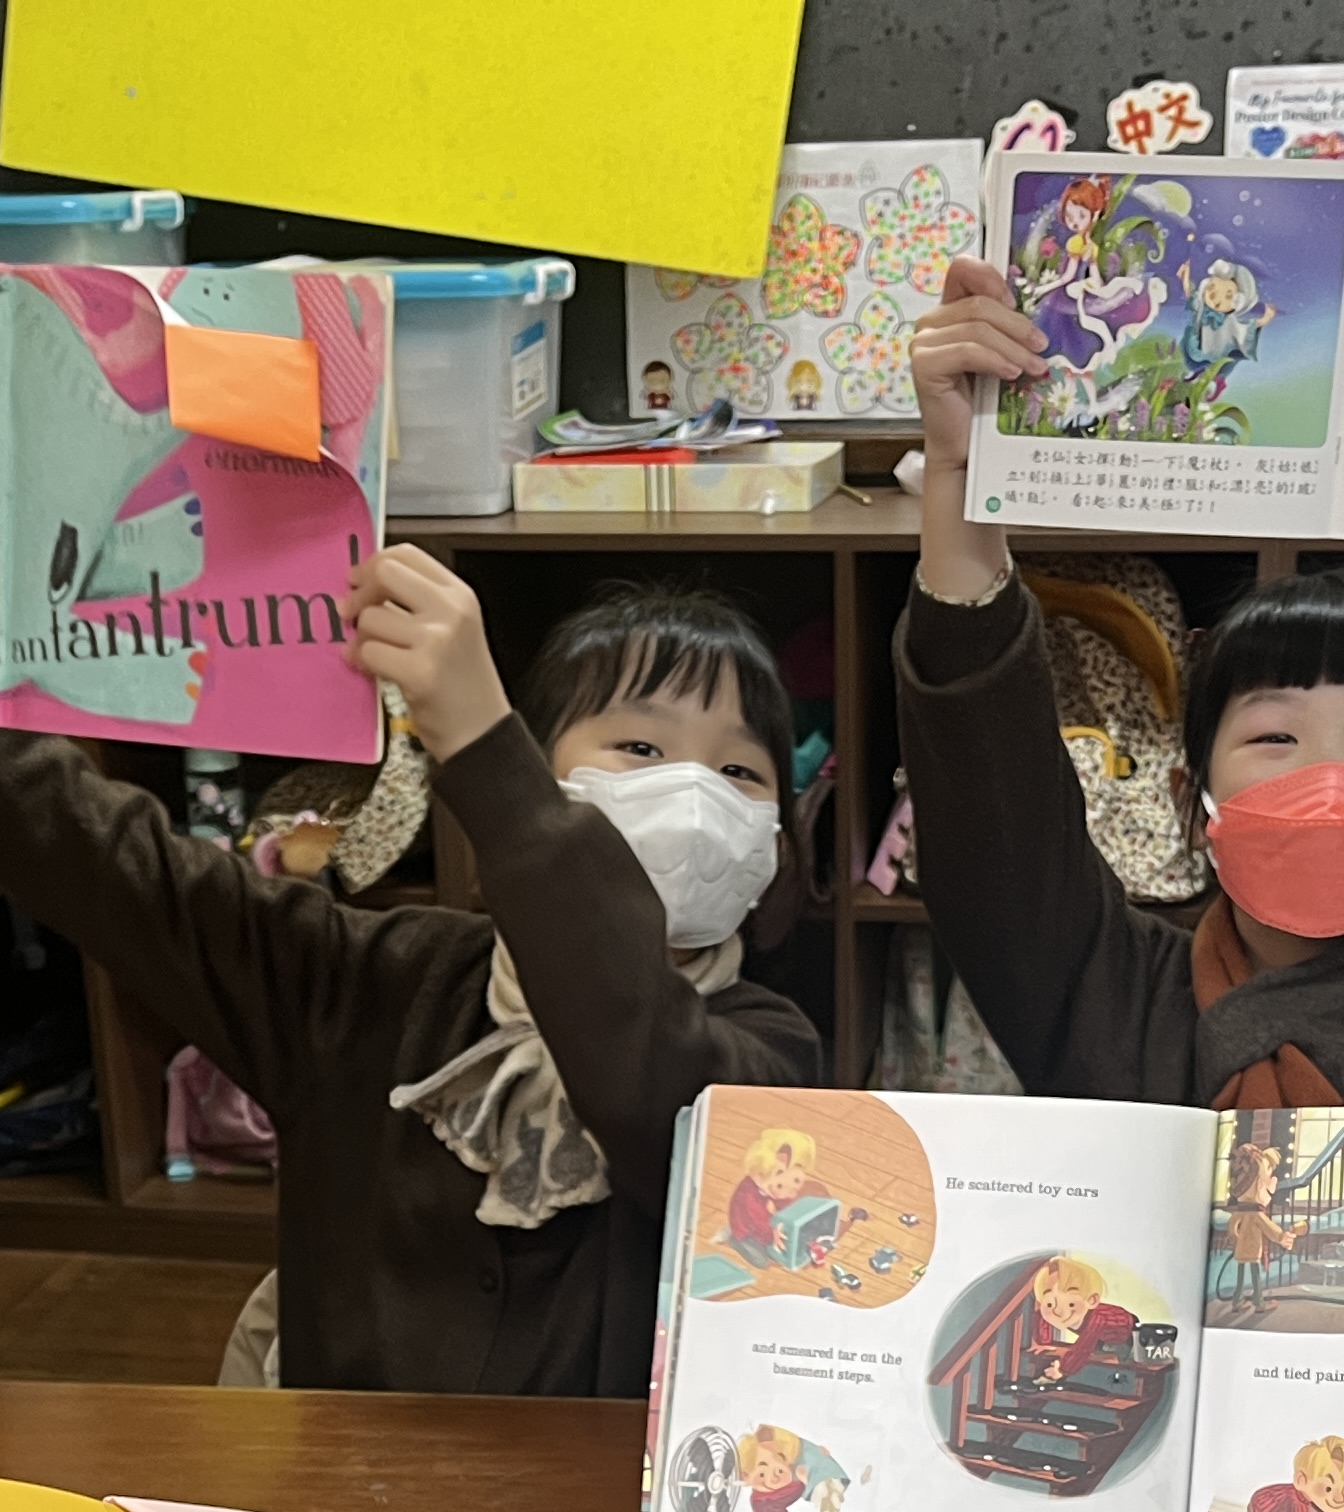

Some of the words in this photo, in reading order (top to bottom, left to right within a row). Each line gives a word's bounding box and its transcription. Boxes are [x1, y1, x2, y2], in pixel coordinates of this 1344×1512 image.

[1116, 92, 1202, 155] 中文
[946, 1177, 964, 1189] He
[968, 1180, 1033, 1193] scattered
[1038, 1184, 1061, 1197] toy
[1066, 1187, 1099, 1197] cars
[752, 1343, 776, 1354] and
[779, 1346, 833, 1359] smeared
[838, 1350, 857, 1361] tar
[861, 1353, 877, 1363] on
[882, 1353, 902, 1365] the
[1145, 1346, 1171, 1359] TAR
[773, 1363, 834, 1379] basement
[837, 1370, 874, 1384] steps.
[1254, 1367, 1279, 1379] and
[1284, 1368, 1311, 1380] tied
